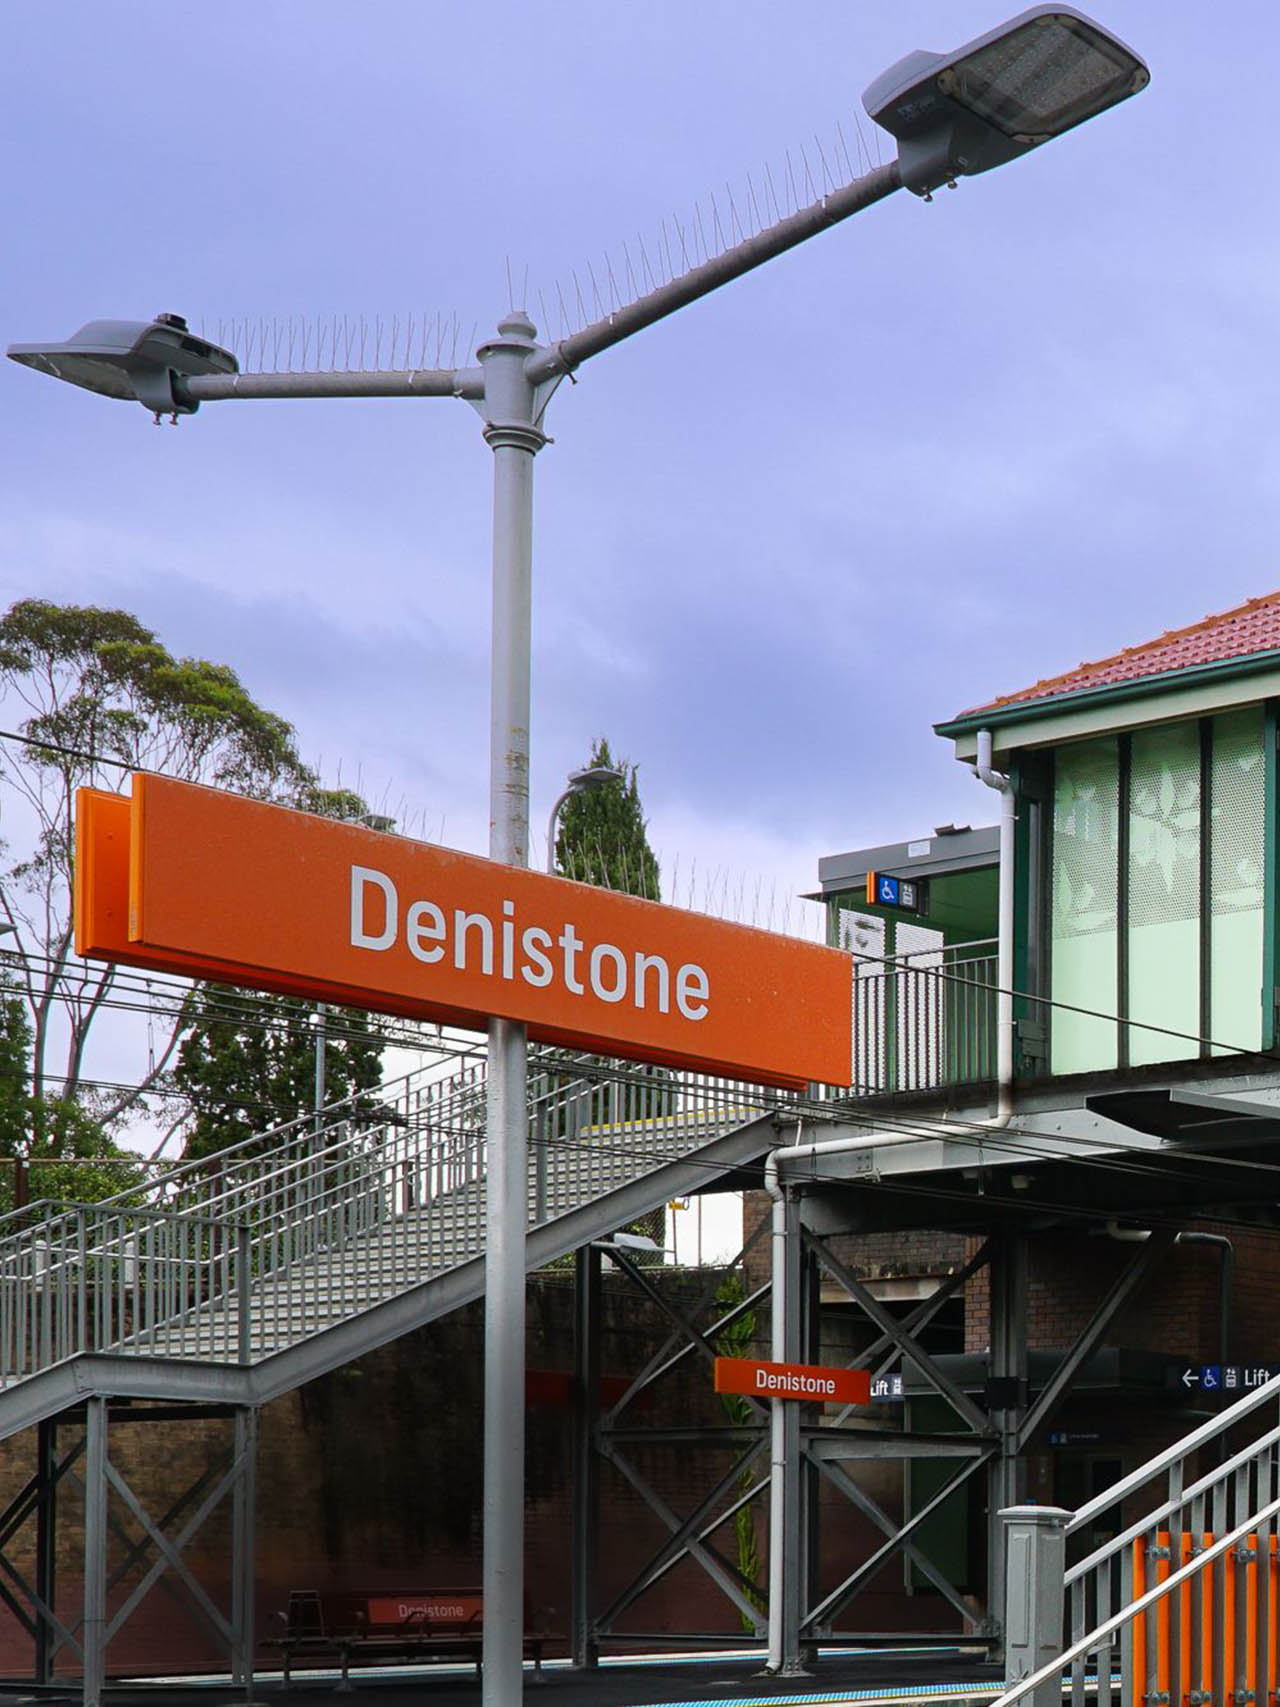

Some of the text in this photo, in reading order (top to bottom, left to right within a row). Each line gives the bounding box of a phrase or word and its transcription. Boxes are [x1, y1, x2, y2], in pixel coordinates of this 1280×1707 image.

[350, 865, 710, 1021] Denistone
[756, 1369, 836, 1394] Denistone
[1244, 1368, 1271, 1386] Lift
[870, 1379, 889, 1397] Lift
[399, 1604, 464, 1618] Denistone
